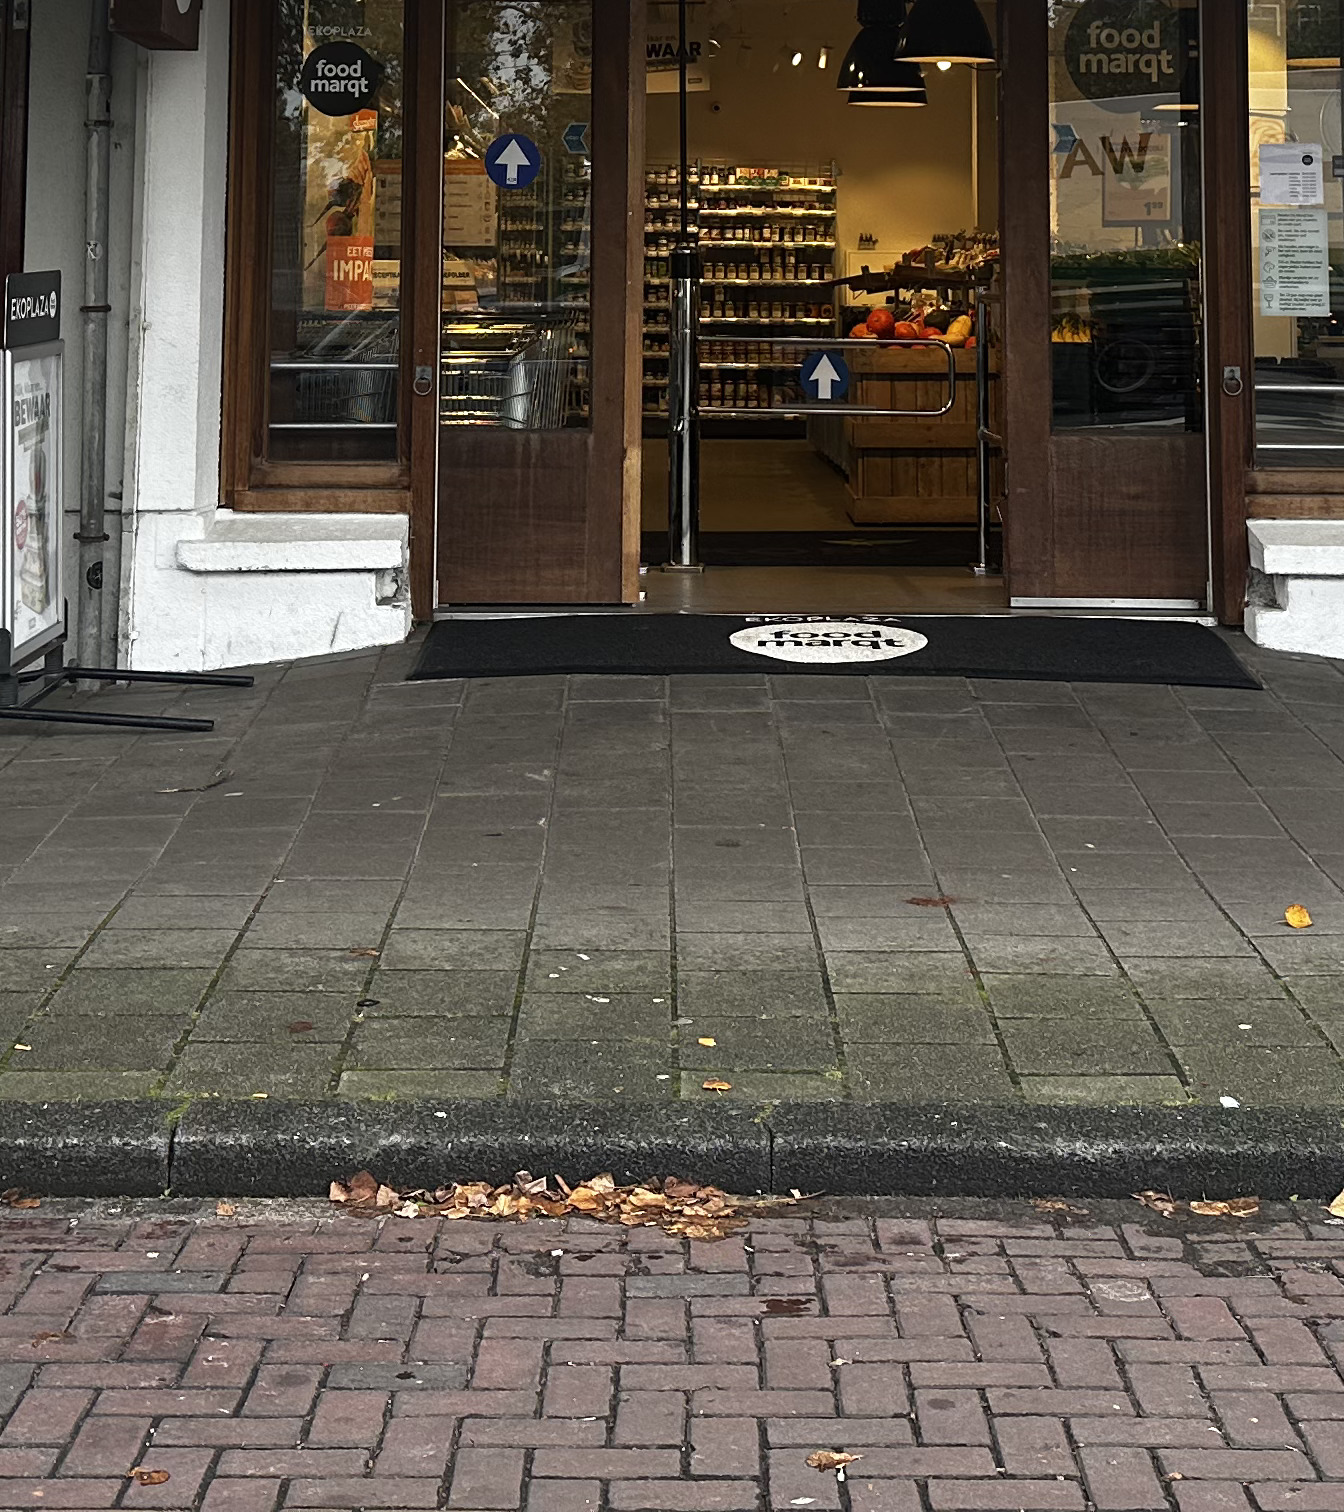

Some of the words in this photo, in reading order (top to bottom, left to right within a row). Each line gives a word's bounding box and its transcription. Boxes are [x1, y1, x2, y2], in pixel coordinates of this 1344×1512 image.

[1086, 20, 1161, 49] food
[315, 59, 362, 78] food
[1079, 48, 1175, 83] marqt
[310, 76, 369, 98] marqt
[11, 294, 49, 321] EKOPLAZA
[14, 391, 51, 427] BEWAAR
[757, 637, 905, 650] marqt
[769, 629, 882, 639] food
